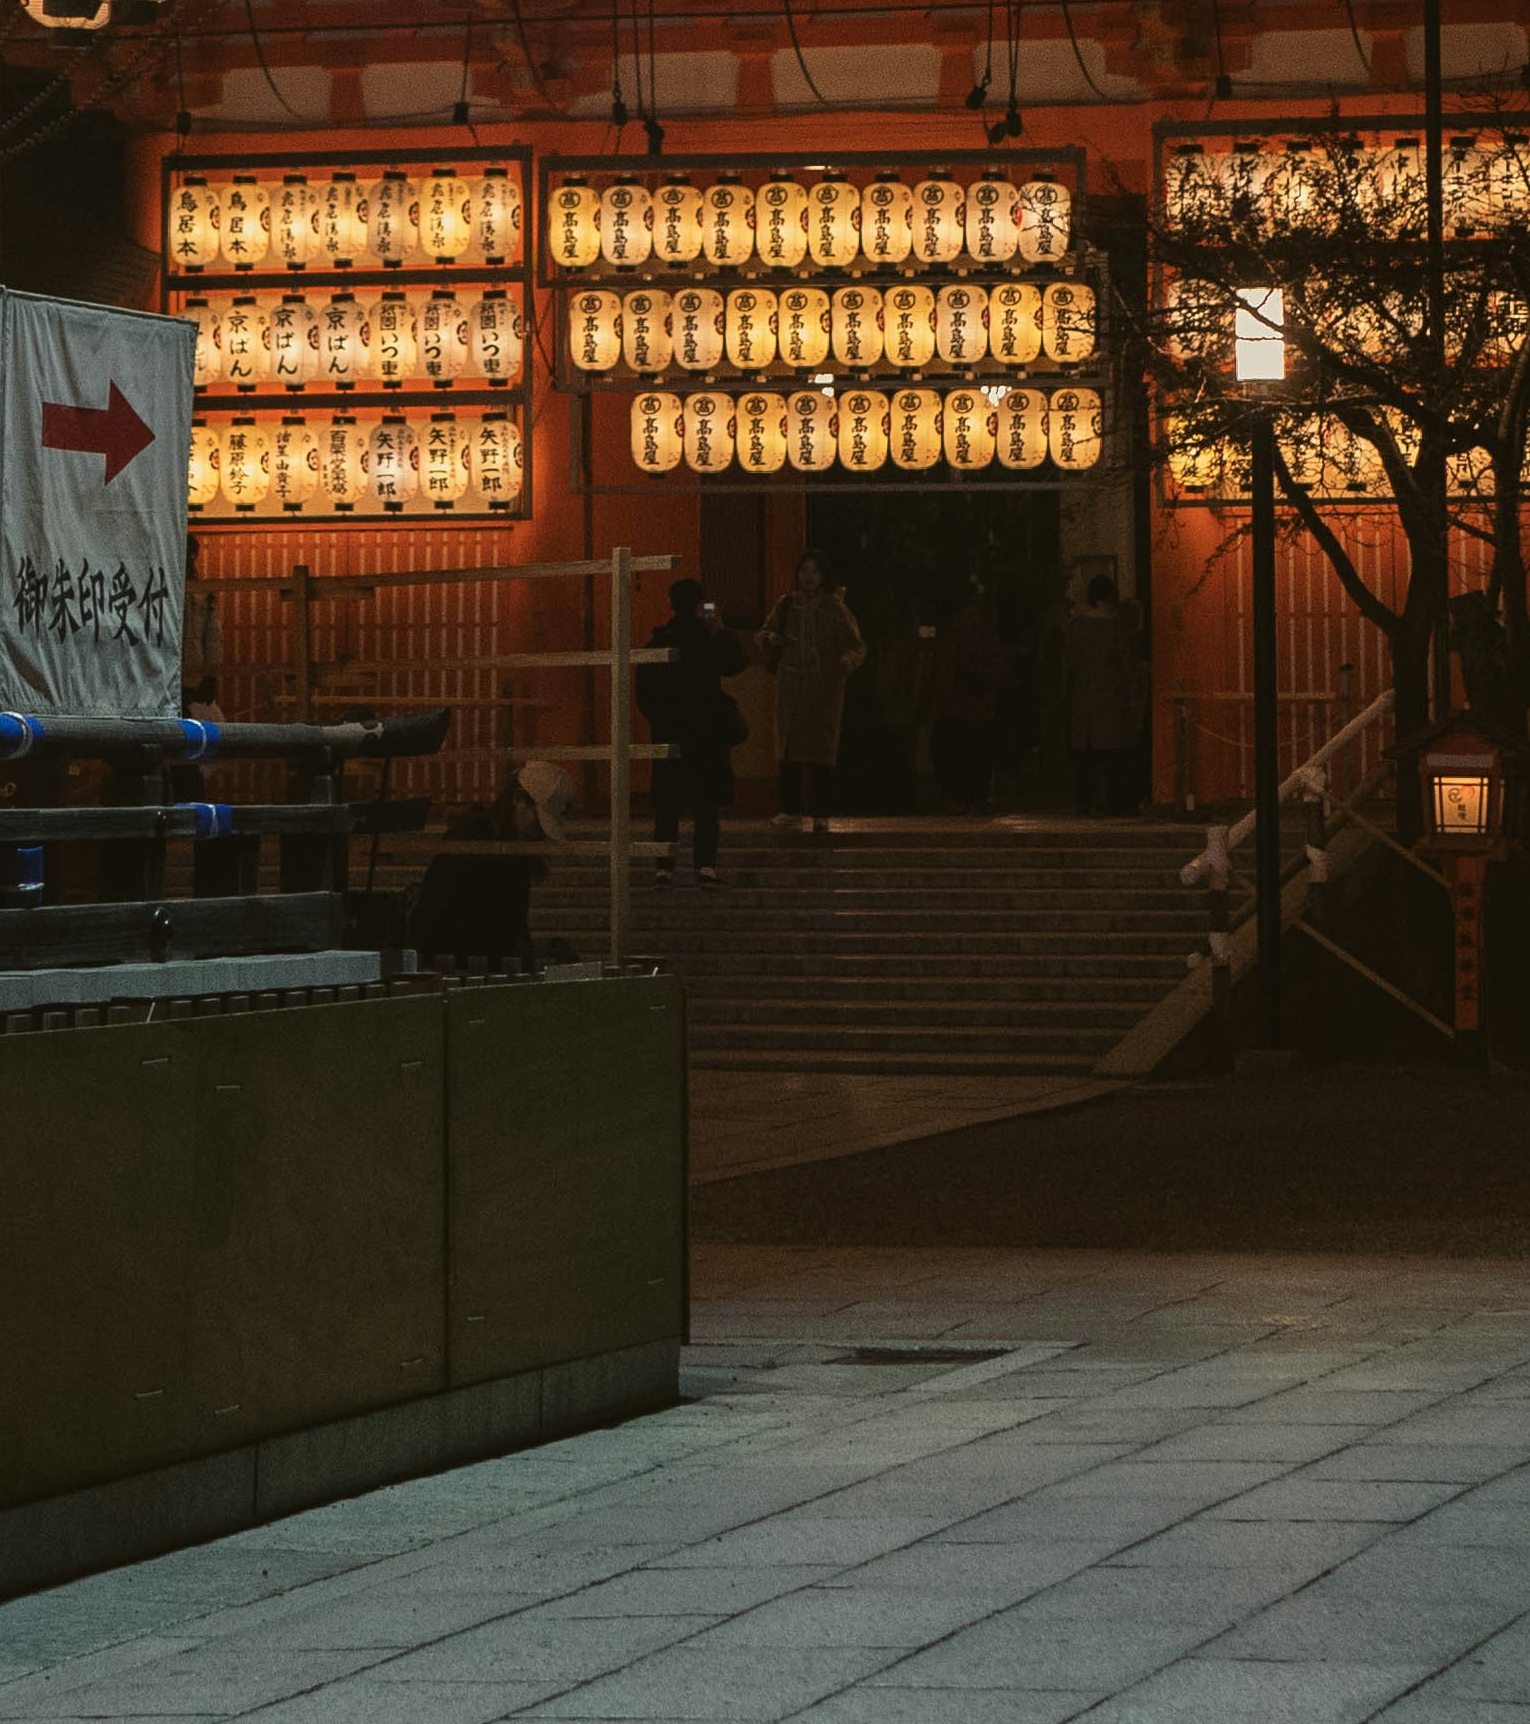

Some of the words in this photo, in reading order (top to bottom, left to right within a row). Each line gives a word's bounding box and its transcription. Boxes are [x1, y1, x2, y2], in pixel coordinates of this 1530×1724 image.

[13, 556, 169, 648] 御朱印受付
